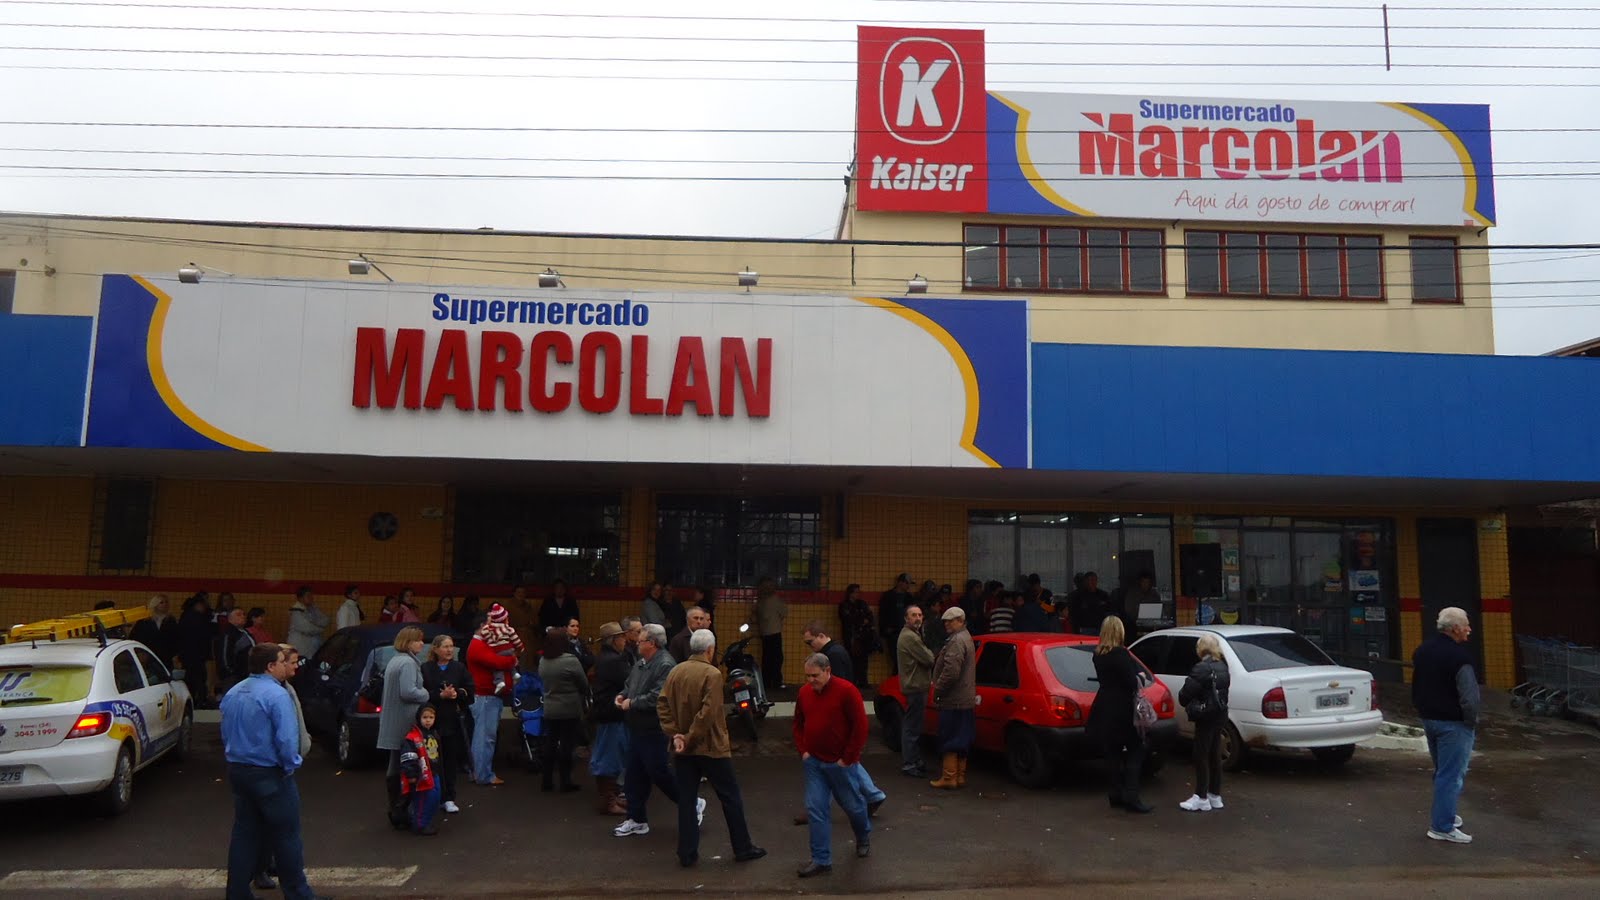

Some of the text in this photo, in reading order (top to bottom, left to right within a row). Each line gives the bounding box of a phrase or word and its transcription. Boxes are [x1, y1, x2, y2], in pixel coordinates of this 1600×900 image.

[896, 55, 951, 127] K
[1139, 100, 1296, 123] Supermercado
[1078, 112, 1403, 183] Marcolan
[870, 155, 974, 192] Kaiser
[1174, 189, 1417, 218] Aqui dá gosto de comprar!
[432, 293, 650, 327] Supermercado
[352, 327, 773, 418] MARCOLAN
